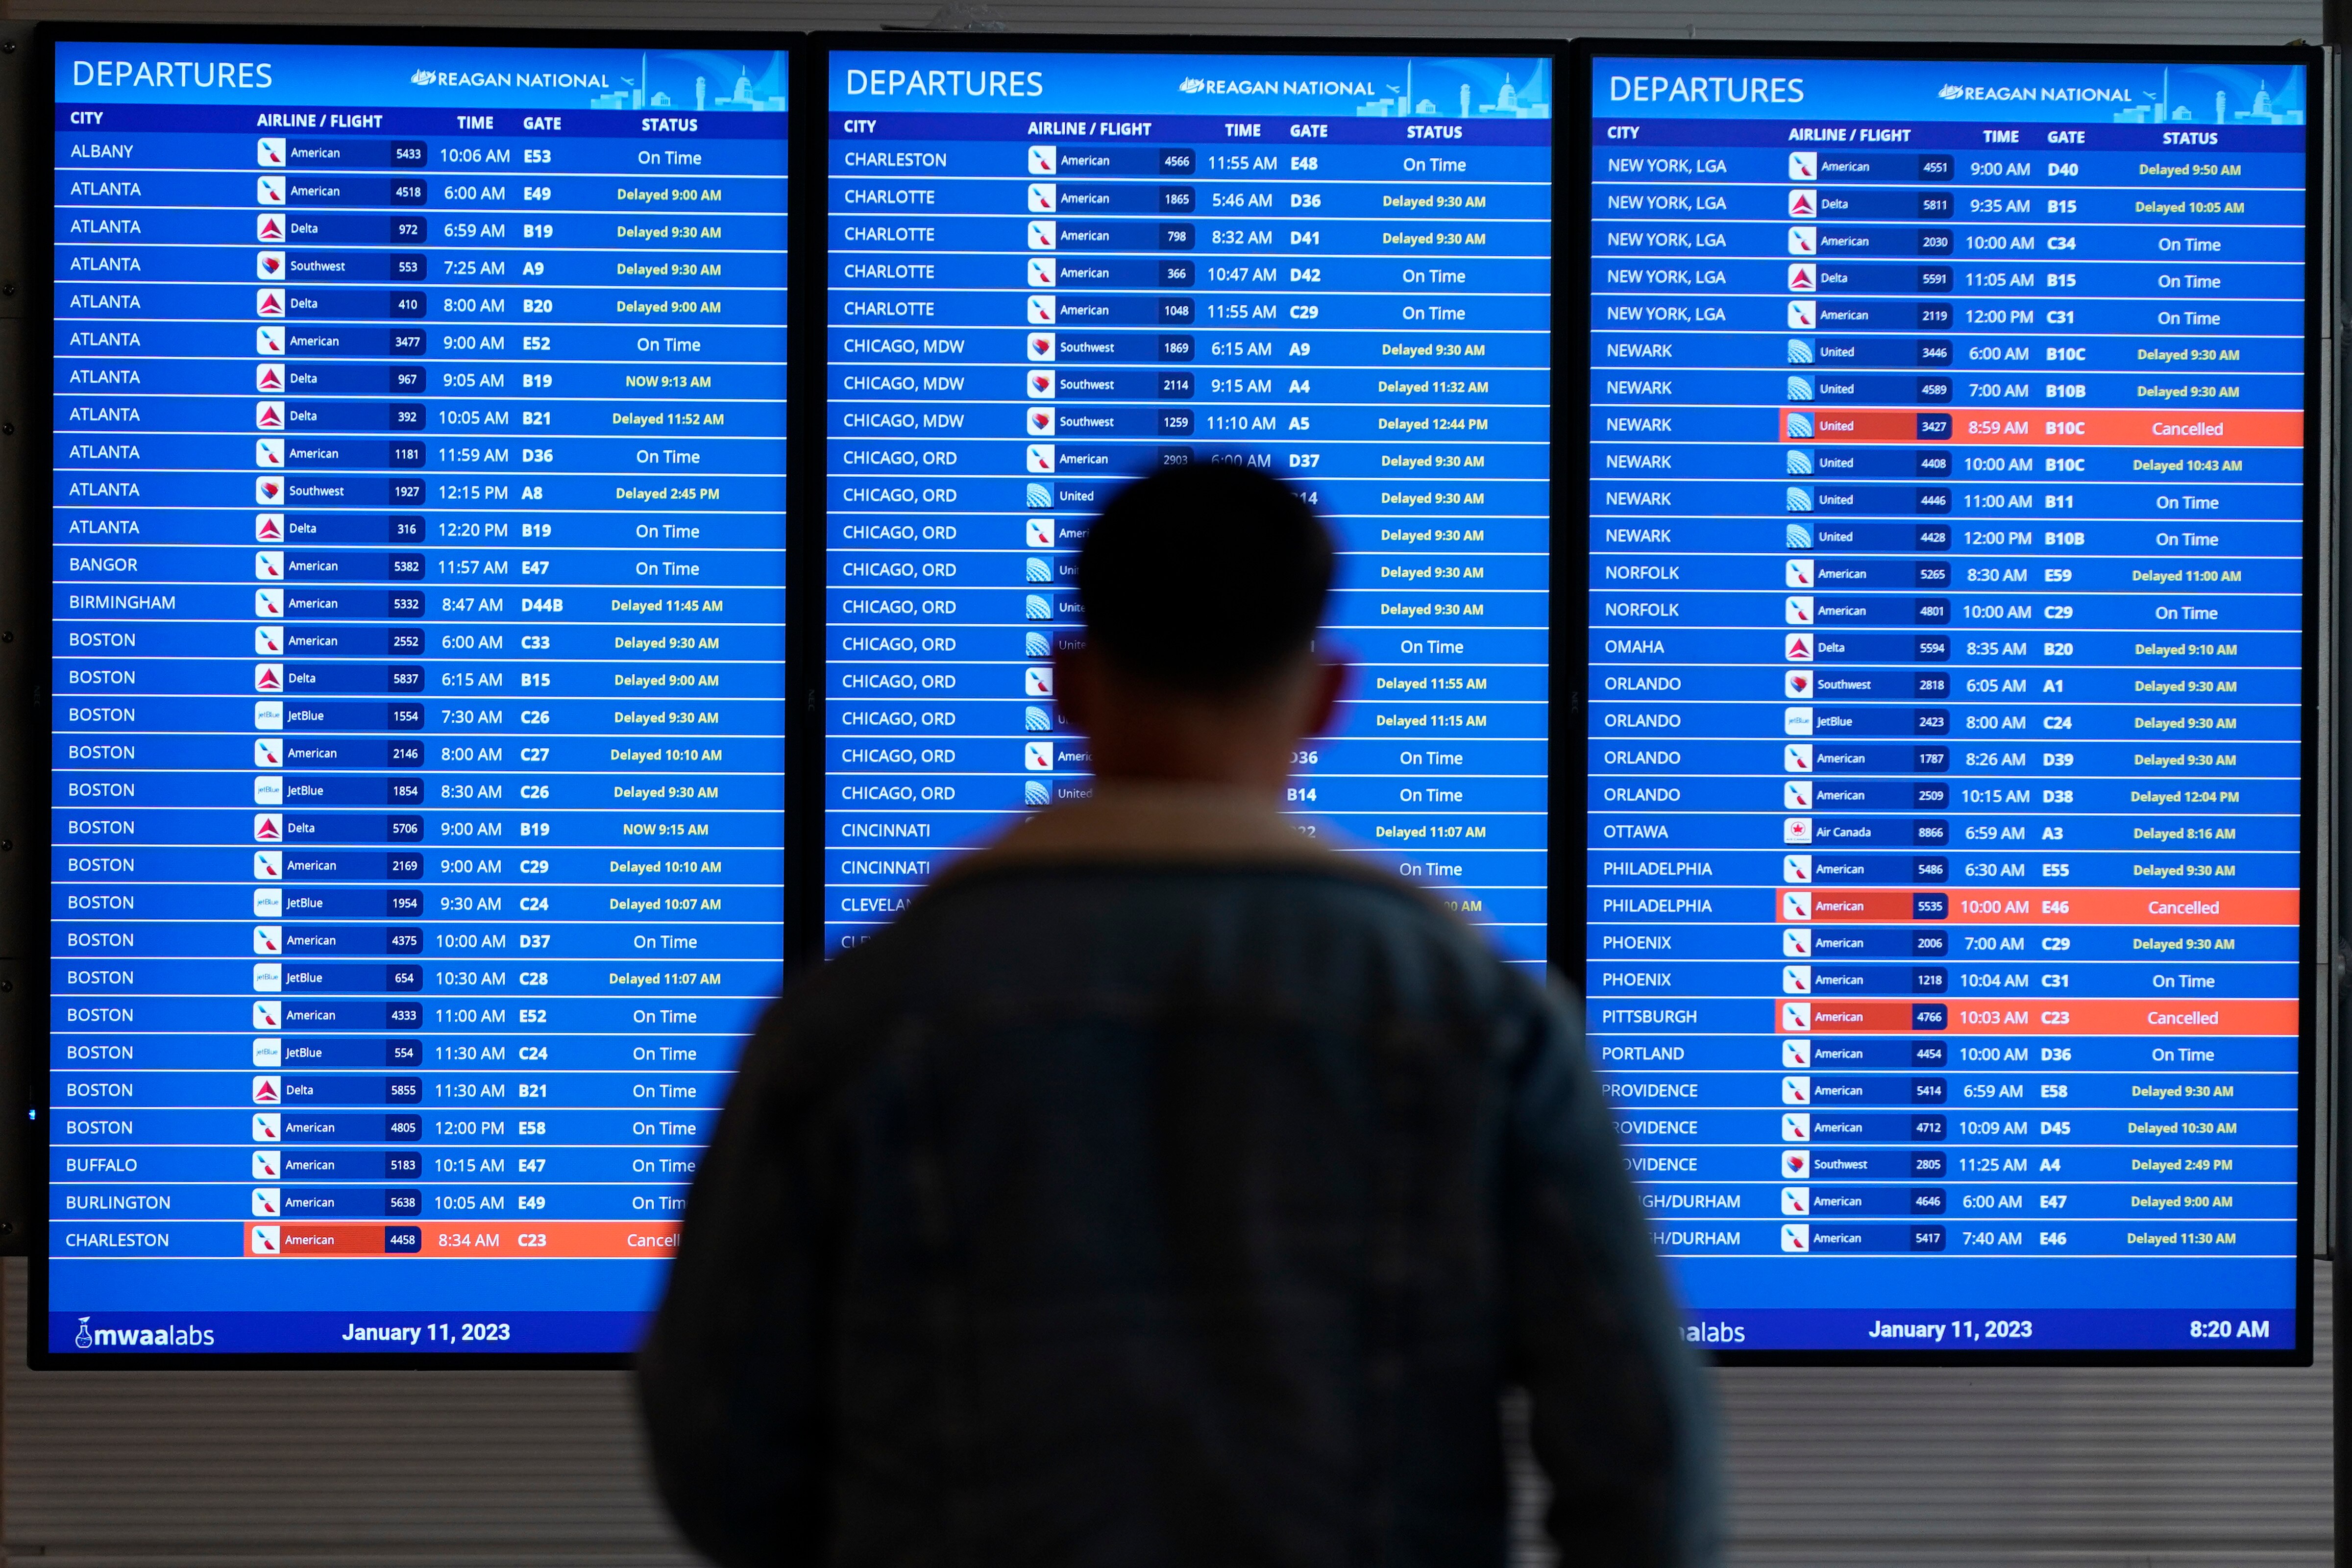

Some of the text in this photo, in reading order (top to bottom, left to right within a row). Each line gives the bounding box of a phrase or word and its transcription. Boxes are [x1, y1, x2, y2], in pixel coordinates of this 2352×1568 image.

[74, 61, 272, 88] DEPARTURES
[439, 72, 609, 88] REAGAN NATIONAL
[848, 69, 1043, 97] DEPARTURES
[1206, 80, 1375, 95] REAGAN NATIONAL
[1611, 76, 1804, 102] DEPARTURES
[1965, 87, 2132, 101] REAGAN NATIONAL
[71, 111, 103, 124] CITY
[257, 113, 316, 127] AIRLINE
[331, 114, 383, 128] FLIGHT
[457, 116, 493, 129] TIME
[523, 117, 561, 130] GATE
[642, 118, 698, 131] STATUS
[844, 120, 877, 133] CITY
[1028, 122, 1086, 135] AIRLINE
[1101, 122, 1152, 136] FLIGHT
[1225, 123, 1261, 137] TIME
[1290, 124, 1328, 137] GATE
[1407, 125, 1463, 139] STATUS
[1607, 126, 1640, 139] CITY
[1788, 128, 1847, 141] AIRLINE
[1860, 128, 1911, 142] FLIGHT
[1983, 130, 2019, 143] TIME
[2048, 131, 2085, 144] GATE
[2163, 132, 2218, 145] STATUS
[71, 144, 702, 165] ALBANY American 5433 10:06 AM E53 On Time
[1609, 158, 2241, 178] NEW YORK, LGA American 4551 9:00 AM D40 Delayed 9:50 AM
[845, 190, 1486, 210] CHARLOTTE American 1865 5:46 AM D36 Delayed 9:30 AM
[844, 376, 1489, 395] CHICAGO, MDW Southwest 2114 9:15 AM A4 Delayed 11:32 AM
[1607, 418, 2224, 436] NEWARK United 3427 8:59 AM B10C Cancelled
[69, 483, 719, 502] ATLANTA Southwest 1927 12:15 PM A8 Delayed 2:45 PM
[843, 488, 1484, 507] CHICAGO, ORD United 14 Delayed 9:30 AM
[70, 595, 723, 614] BIRMINGHAM American 5332 8:47 AM D44B Delayed 11:45 AM
[70, 708, 135, 721] BOSTON
[287, 710, 324, 722] JetBlue
[394, 711, 418, 721] 1554
[441, 710, 474, 723] 7:30
[478, 710, 502, 723] AM
[521, 710, 550, 724] C26
[614, 711, 665, 726] Delayed
[669, 712, 695, 723] 9:30
[698, 712, 718, 723] AM
[841, 824, 1486, 840] CINCINNATI Delayed 11:07 AM
[1604, 825, 1668, 838] OTTAWA
[1816, 827, 1831, 837] Air
[1833, 827, 1871, 837] Canada
[1919, 828, 1943, 837] 8866
[1966, 826, 1997, 839] 6:59
[2001, 827, 2025, 839] AM
[2042, 827, 2063, 840] A3
[2134, 827, 2184, 842] Delayed
[2187, 828, 2212, 839] 8:16
[2215, 828, 2236, 839] AM
[1603, 1010, 2219, 1025] PITTSBURGH American 4766 10:03 AM C23 Cancelled
[66, 1233, 680, 1248] CHARLESTON American 4458 8:34 AM C23 Cancell
[95, 1324, 214, 1346] mwaalabs
[342, 1323, 510, 1345] January 11, 2023
[1869, 1320, 2033, 1342] January 11, 2023
[2190, 1321, 2269, 1338] 8:20 AM
